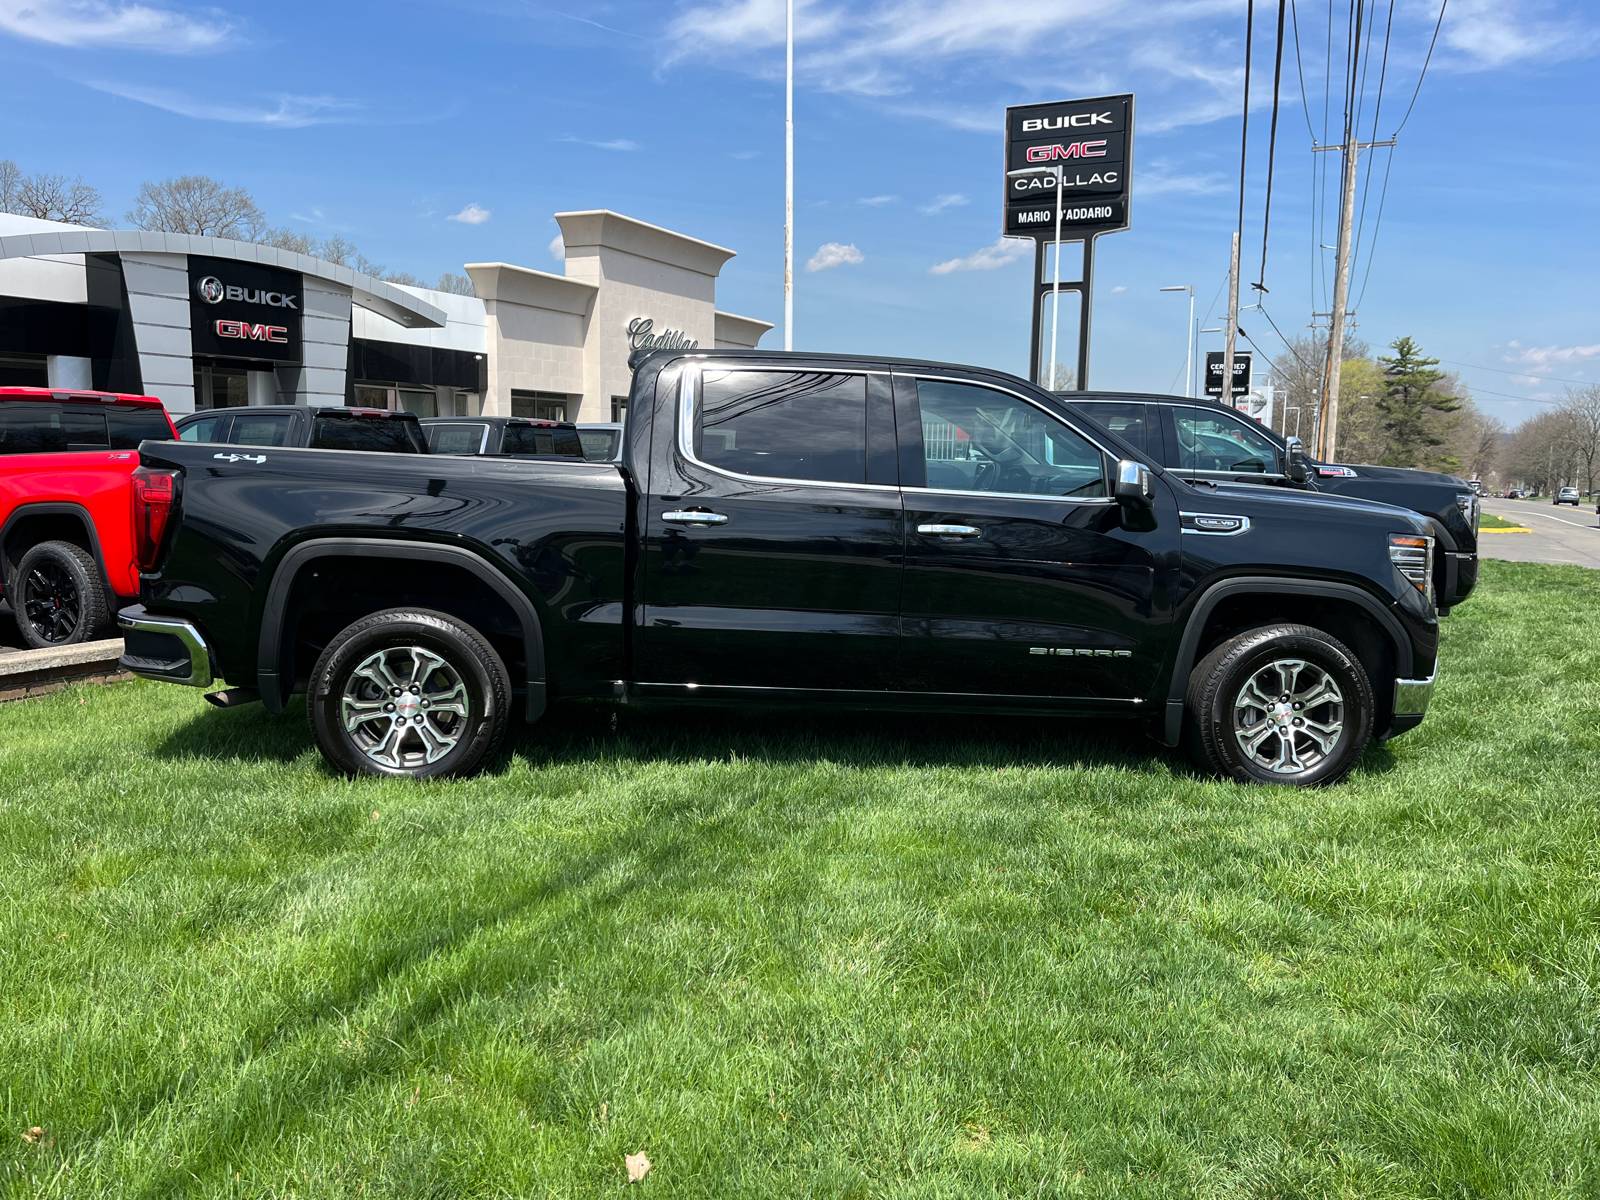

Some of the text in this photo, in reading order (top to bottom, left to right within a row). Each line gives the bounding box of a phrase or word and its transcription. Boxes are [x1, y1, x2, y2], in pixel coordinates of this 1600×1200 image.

[1022, 111, 1113, 132] BUICK
[1026, 139, 1107, 163] GMC
[1014, 171, 1118, 190] CADLLAC
[1018, 210, 1050, 223] MARIO
[225, 284, 298, 310] BUICK
[216, 319, 288, 344] GMC
[629, 317, 698, 350] Cadillac
[1029, 647, 1132, 658] SIERRA
